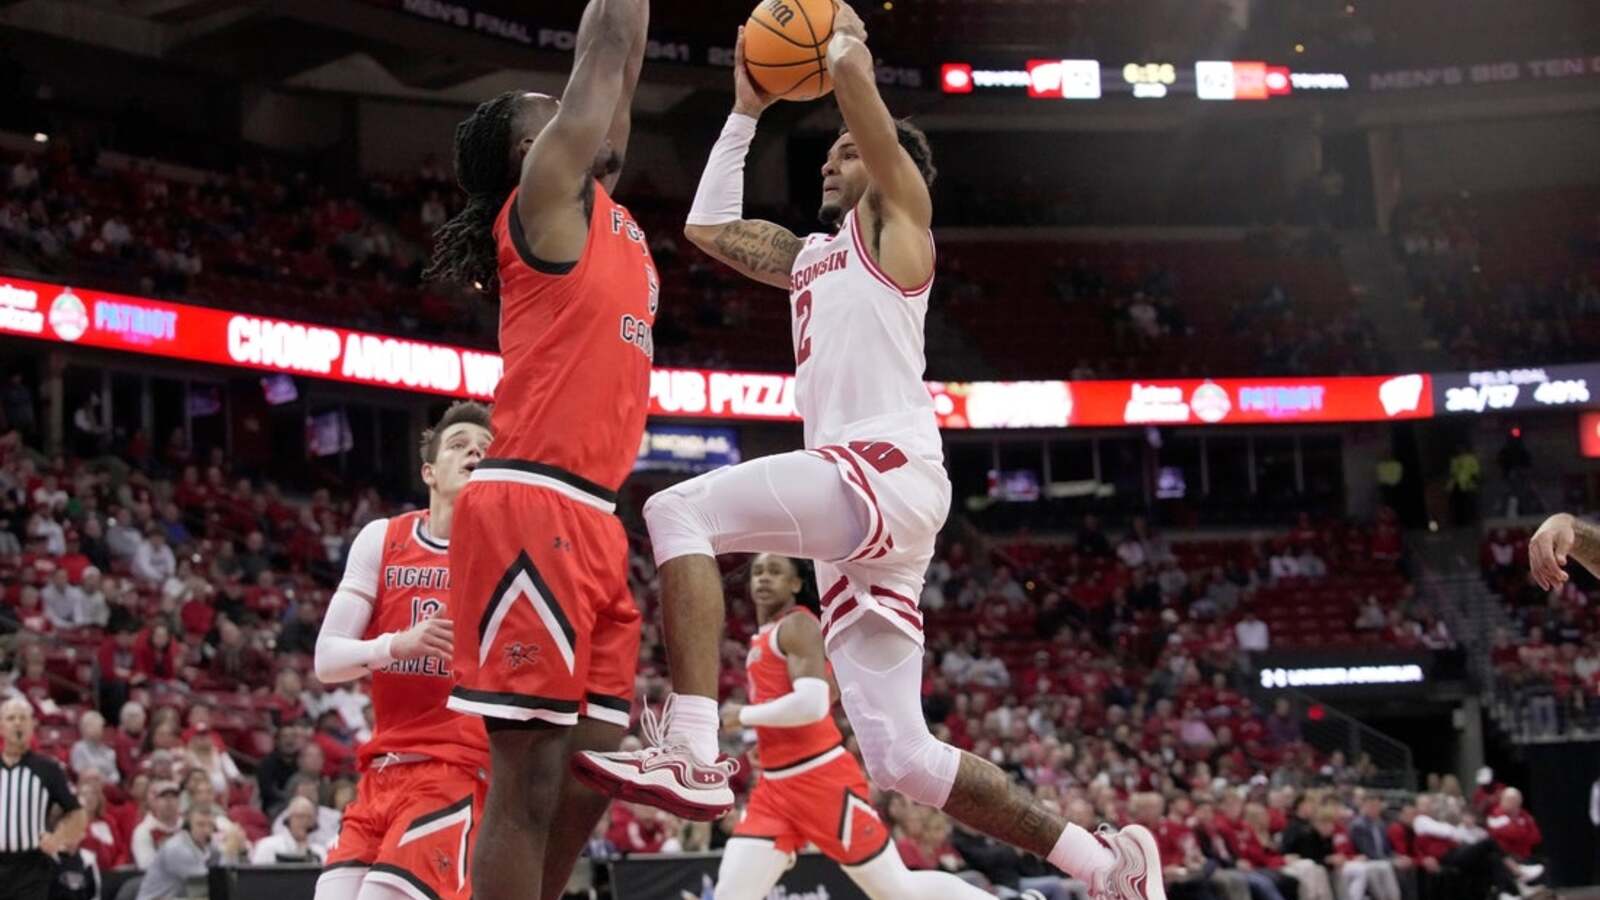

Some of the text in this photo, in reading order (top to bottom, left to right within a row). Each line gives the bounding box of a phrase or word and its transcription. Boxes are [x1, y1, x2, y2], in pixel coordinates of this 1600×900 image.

[538, 28, 577, 50] FO
[644, 40, 689, 62] 941
[227, 314, 341, 374] CHOMP
[341, 332, 462, 392] AROUND
[795, 289, 813, 367] 2
